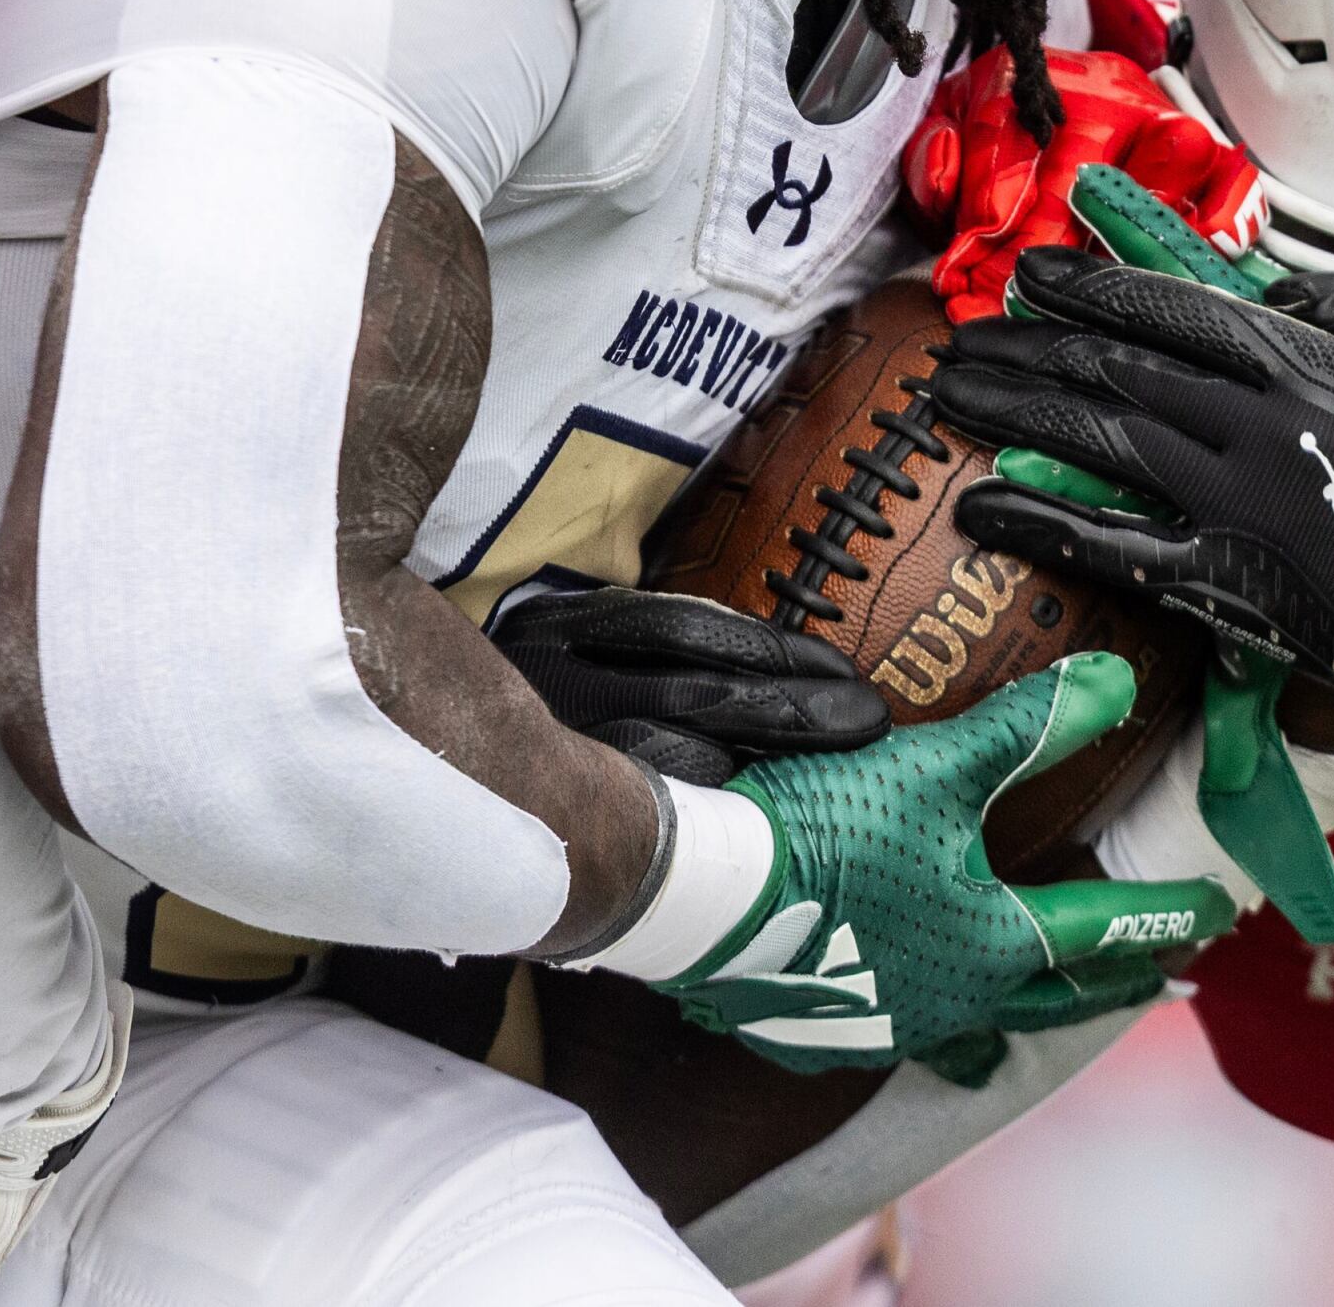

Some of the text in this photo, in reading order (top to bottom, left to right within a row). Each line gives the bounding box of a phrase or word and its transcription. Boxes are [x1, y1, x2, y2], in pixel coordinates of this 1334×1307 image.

[1161, 592, 1297, 661] INSPIRED BY GREATNESS
[1097, 910, 1195, 947] ADIZERO
